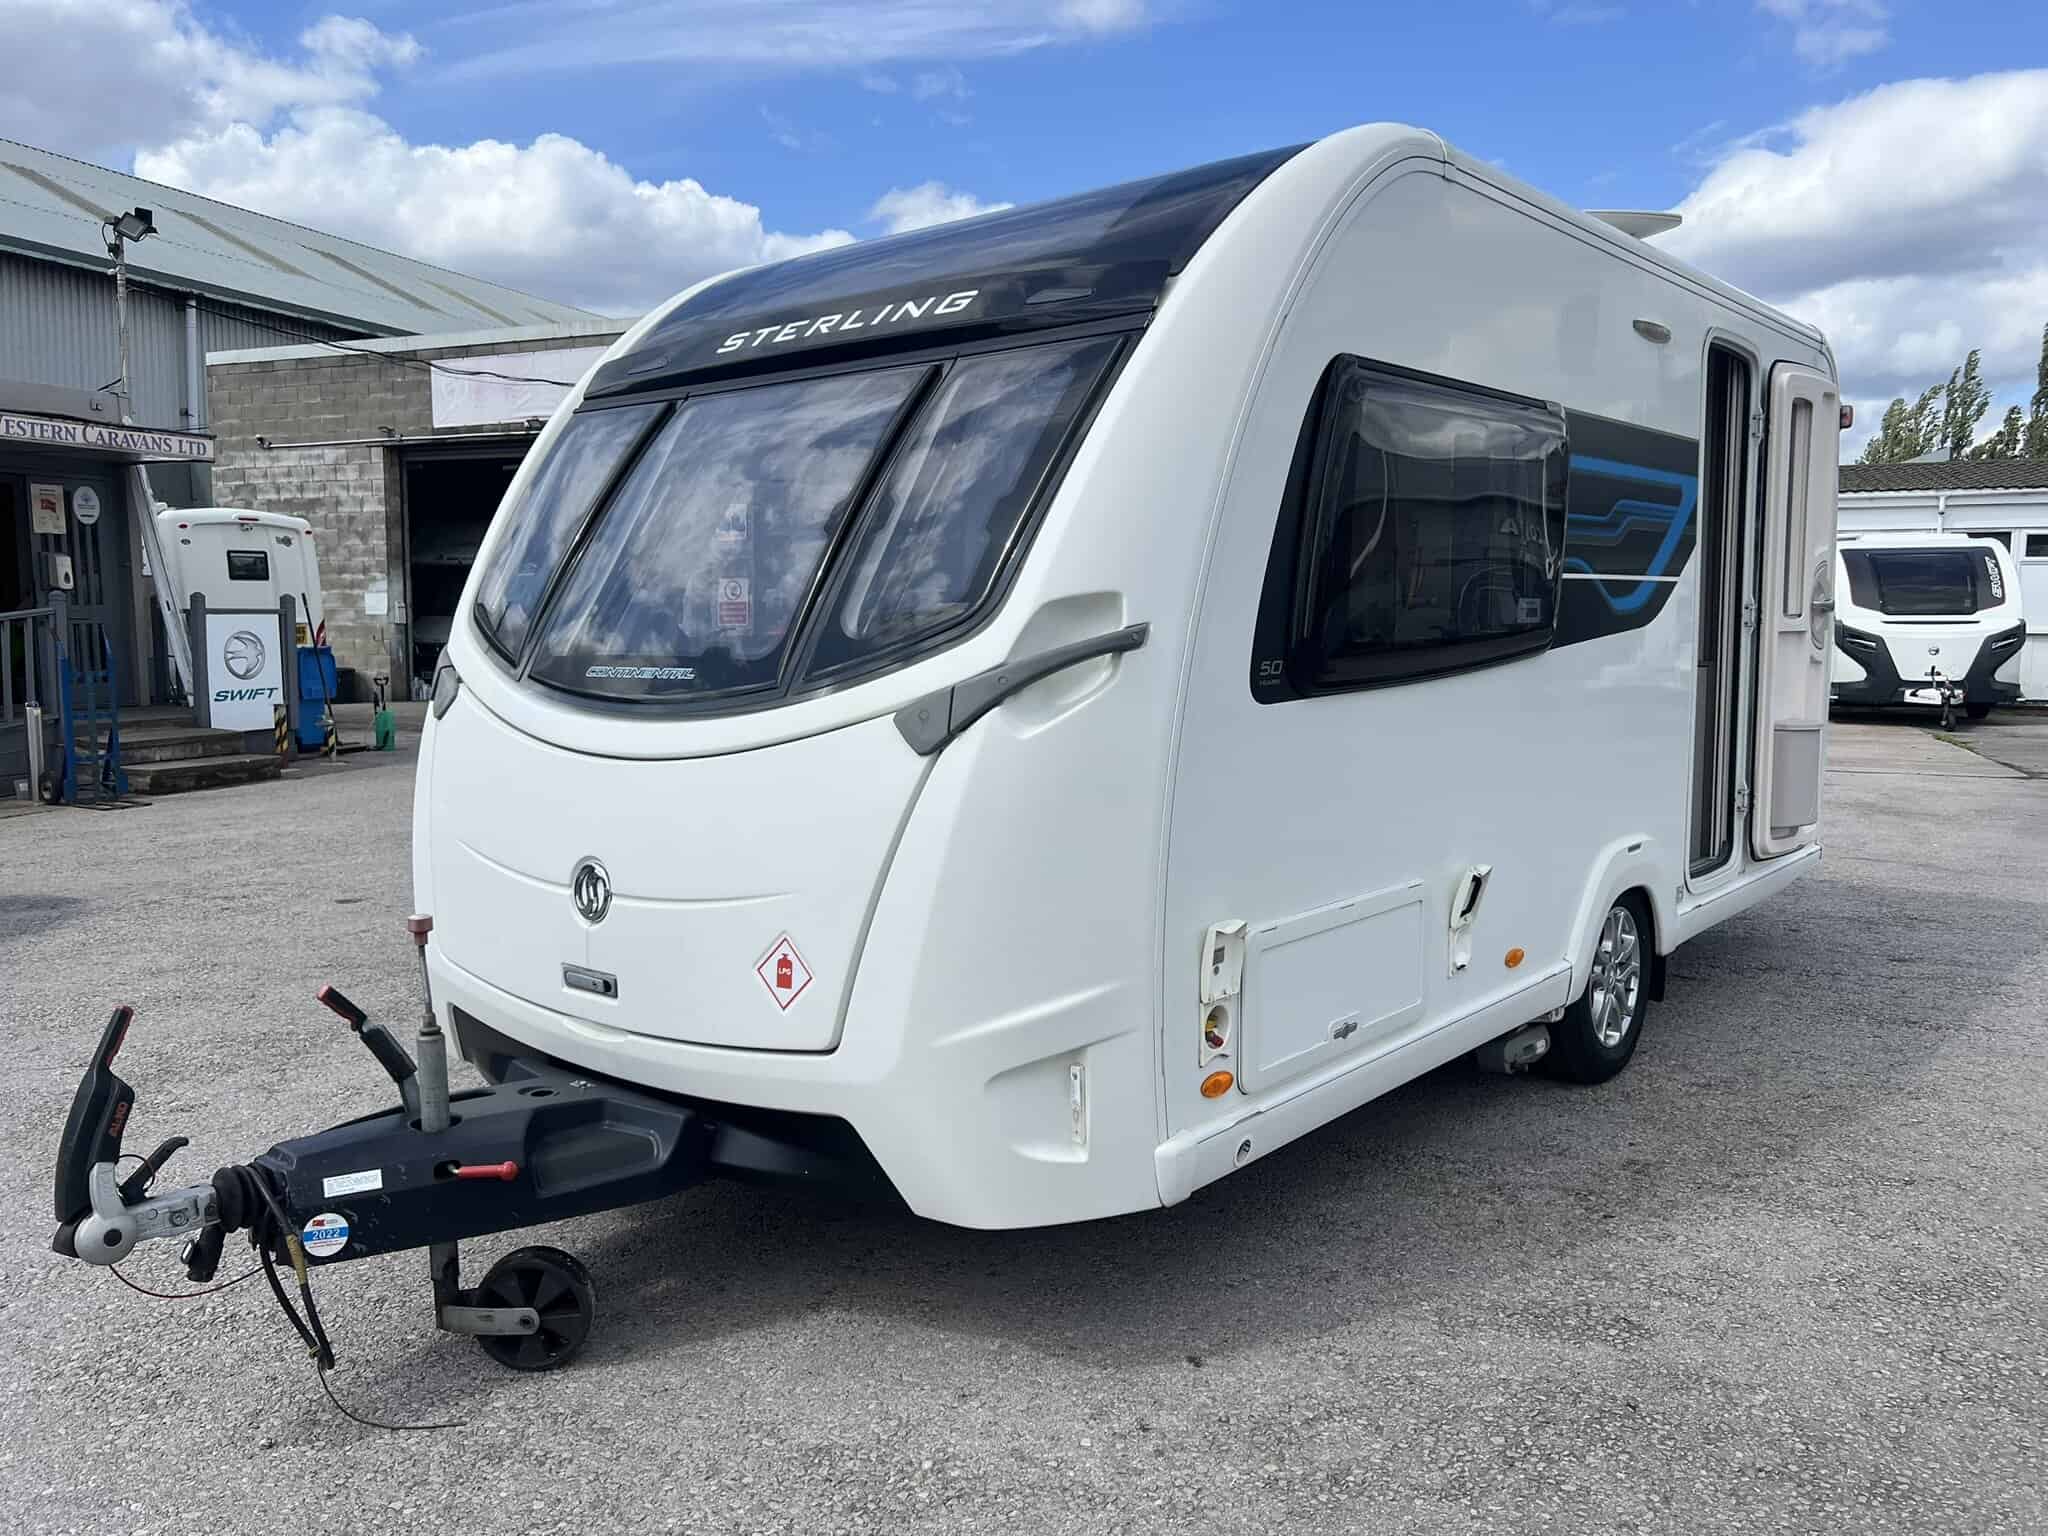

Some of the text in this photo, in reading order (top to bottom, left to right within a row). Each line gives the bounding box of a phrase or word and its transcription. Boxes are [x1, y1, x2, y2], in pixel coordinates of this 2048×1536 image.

[715, 289, 979, 354] STERLING
[0, 417, 207, 456] ESTERN CARAVANS LTD
[1259, 660, 1284, 676] 50
[214, 687, 279, 702] SWIFT
[312, 1228, 340, 1240] 2022
